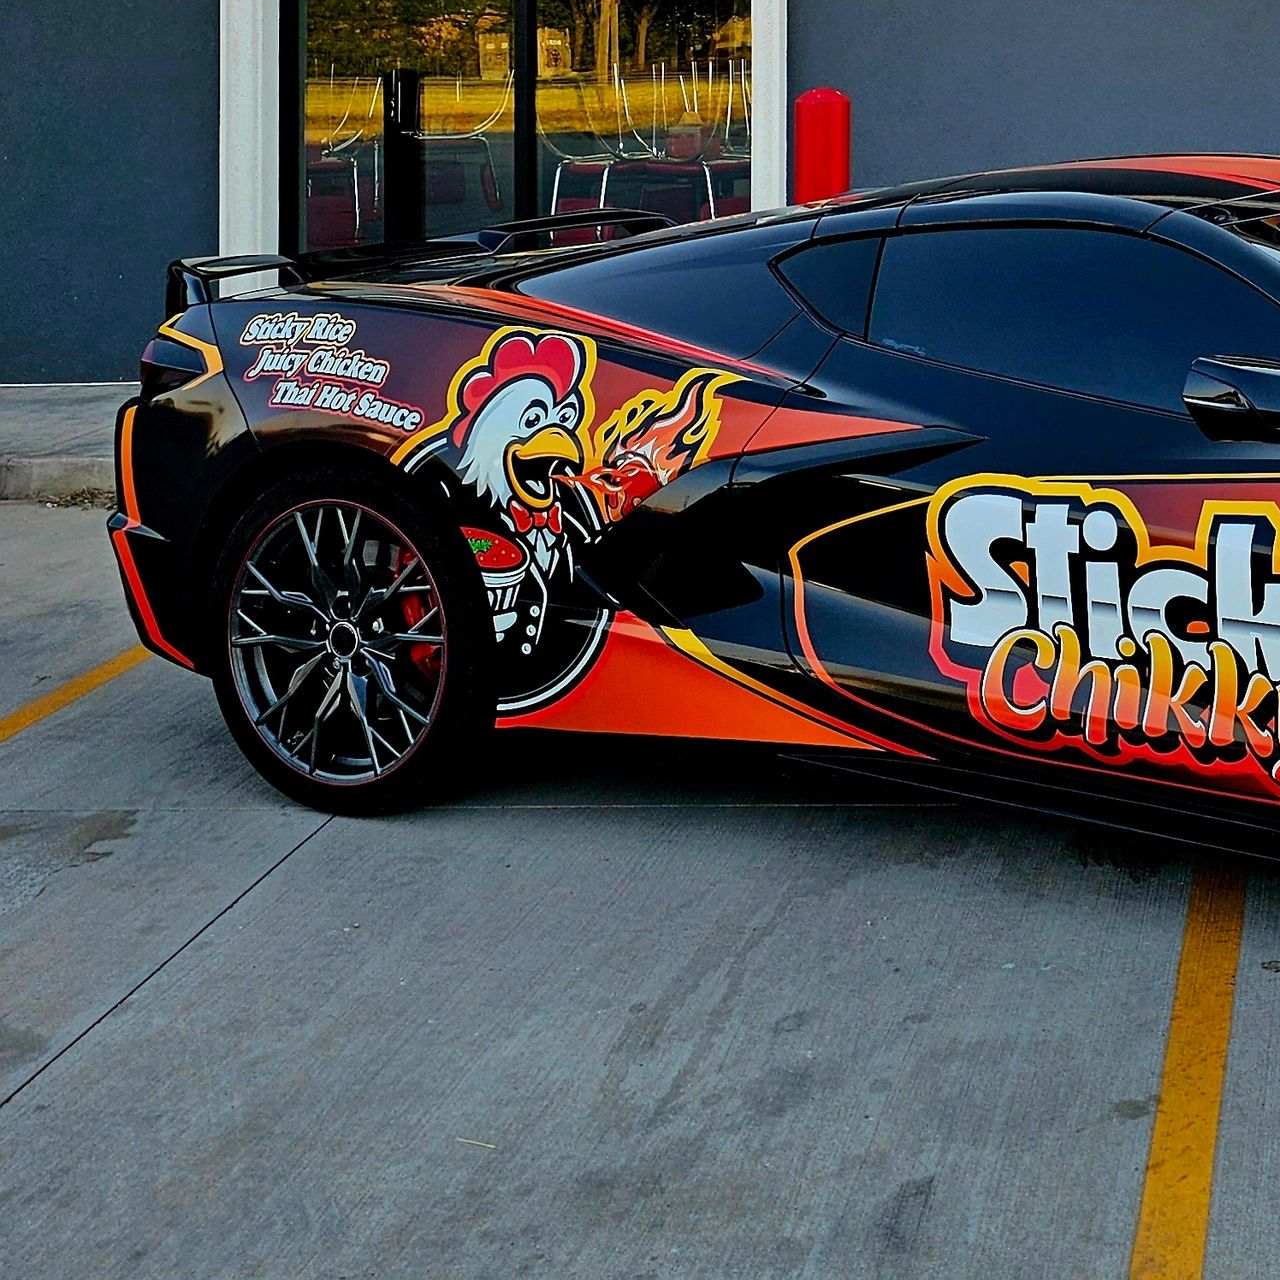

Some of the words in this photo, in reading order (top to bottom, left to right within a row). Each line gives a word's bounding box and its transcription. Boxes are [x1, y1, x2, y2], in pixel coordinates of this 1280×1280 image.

[243, 315, 311, 344] Sticky
[307, 316, 354, 343] Rice
[247, 349, 309, 378] Juicy
[307, 349, 387, 384] Chicken
[271, 381, 320, 406] Thai
[313, 385, 357, 412] Hot
[353, 394, 422, 431] Sauce
